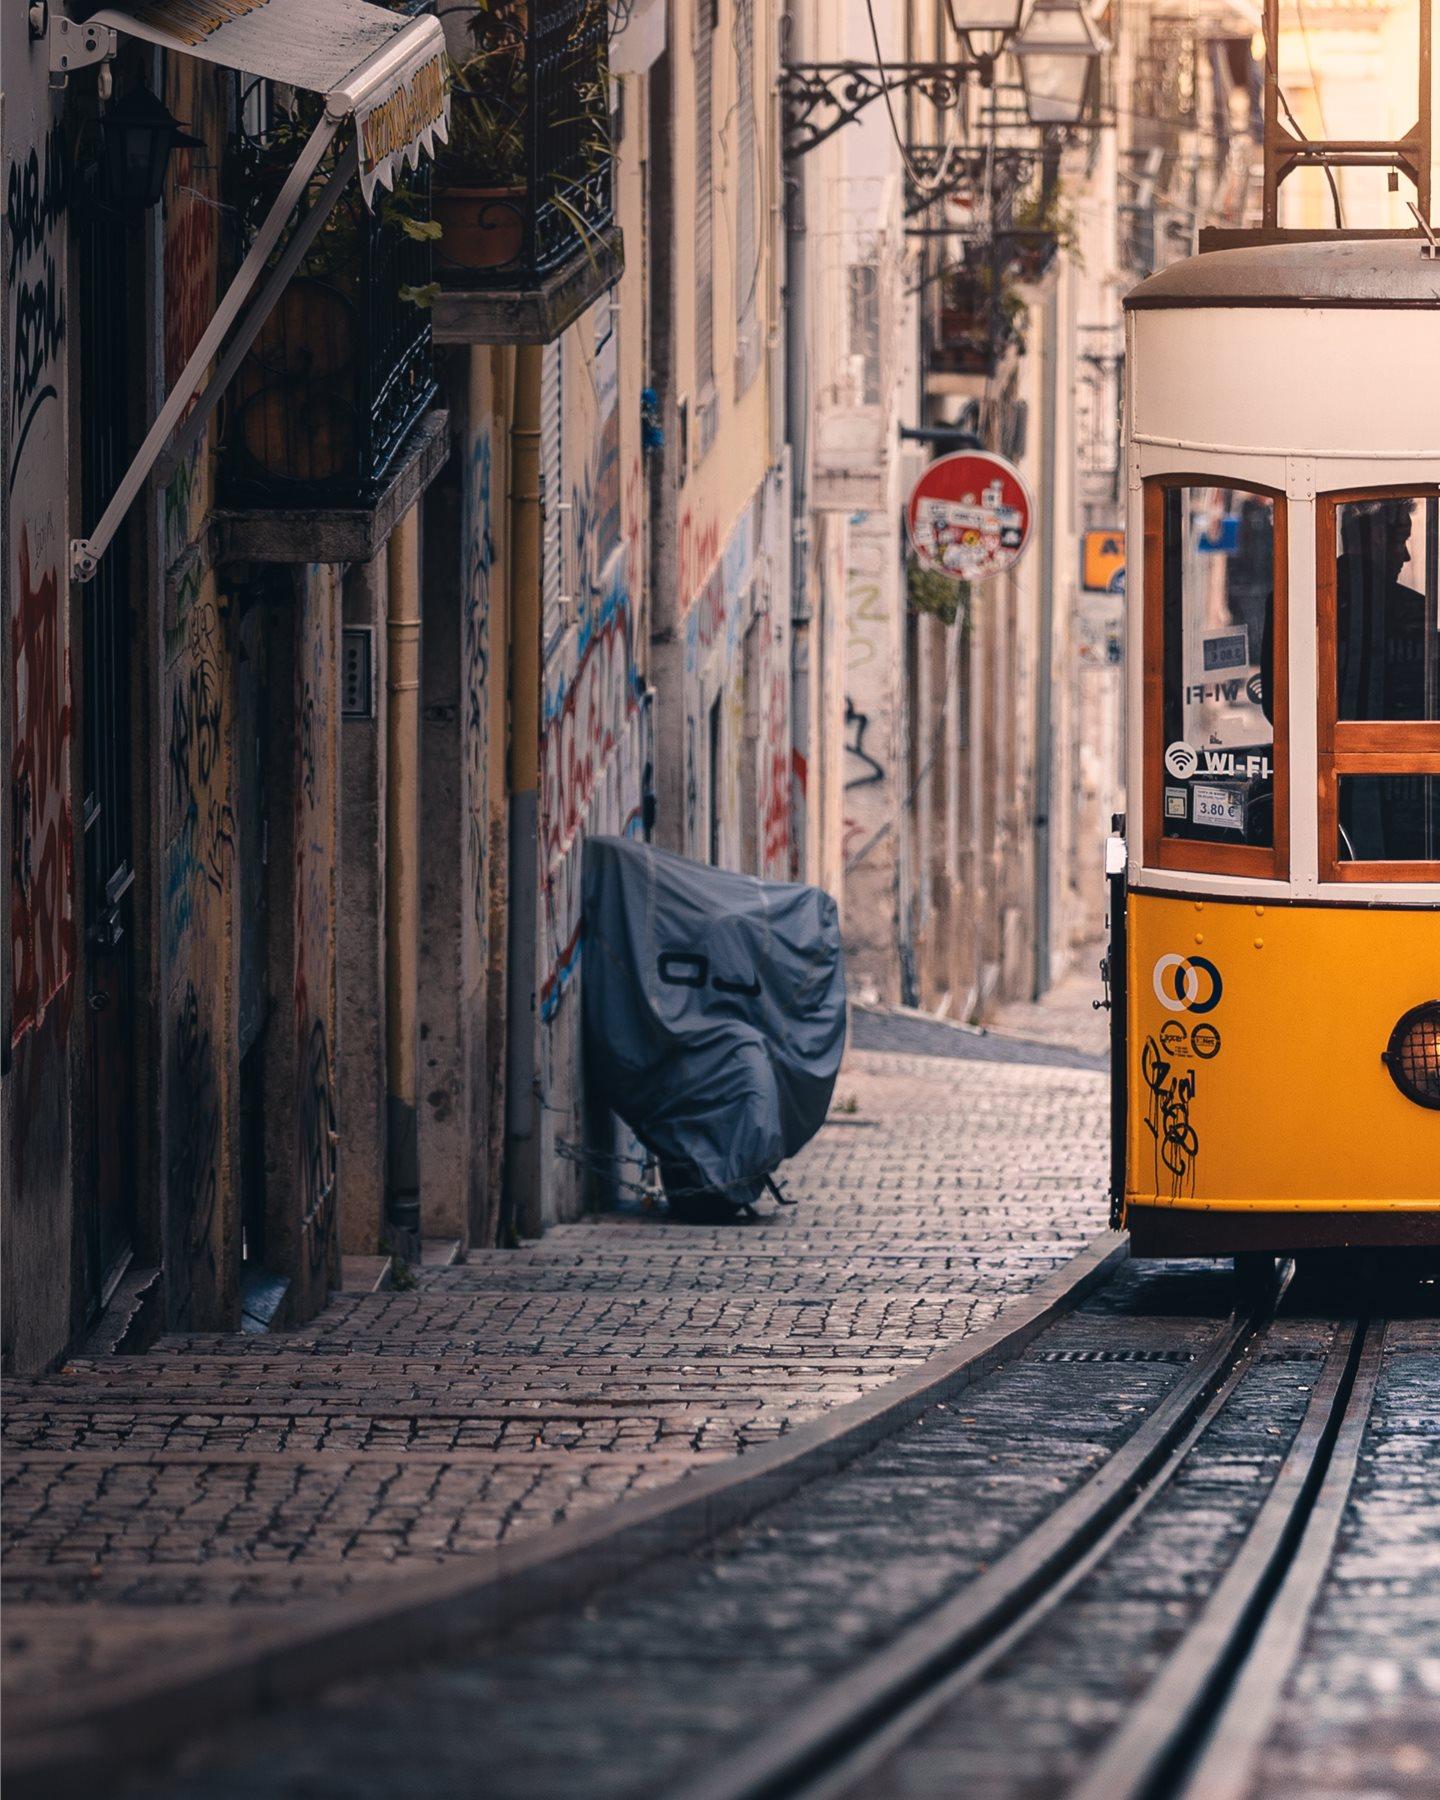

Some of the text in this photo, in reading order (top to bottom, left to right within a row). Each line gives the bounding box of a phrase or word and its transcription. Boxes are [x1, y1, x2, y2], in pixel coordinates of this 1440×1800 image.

[1203, 751, 1268, 779] WI-FI
[1200, 802, 1235, 817] 3.80 €
